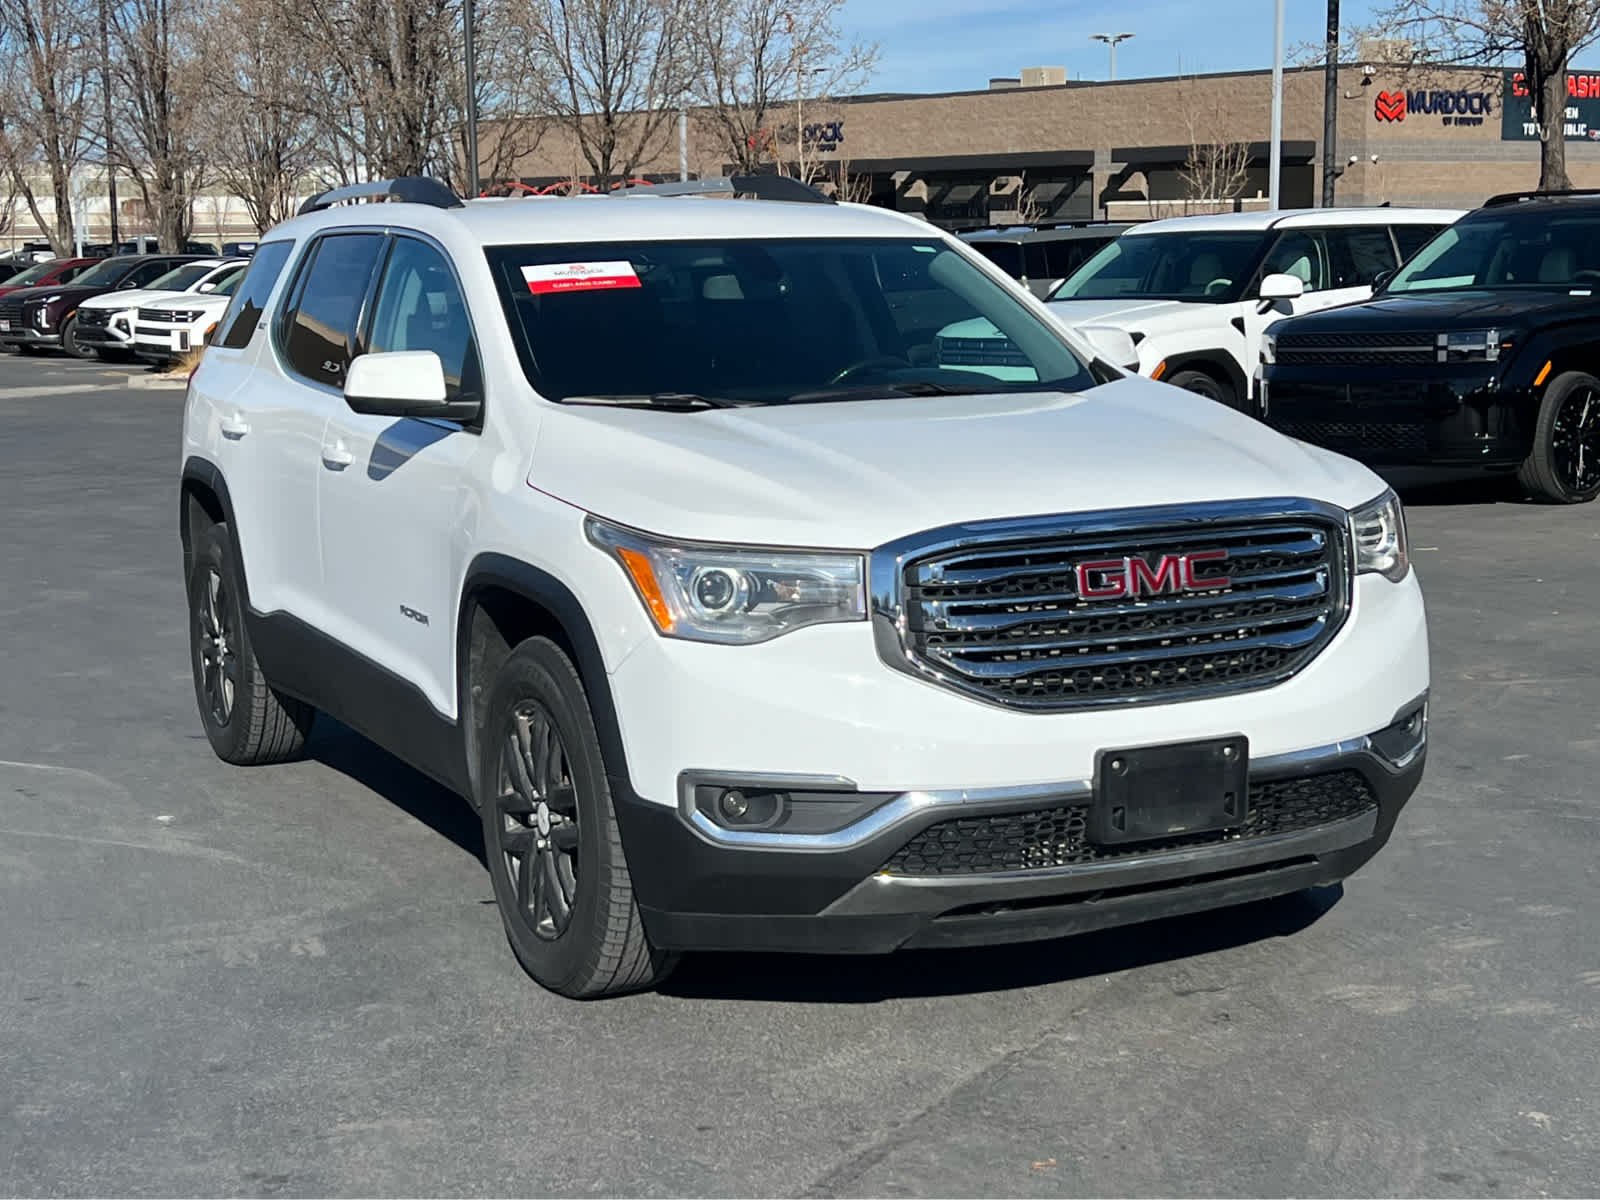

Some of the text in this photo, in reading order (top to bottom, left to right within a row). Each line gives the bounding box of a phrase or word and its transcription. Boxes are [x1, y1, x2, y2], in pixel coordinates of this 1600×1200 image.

[1567, 75, 1600, 98] ASH
[1406, 89, 1492, 115] MURDOCK
[1522, 122, 1535, 136] TO
[1563, 123, 1587, 136] BLIC
[1076, 549, 1231, 600] GMC
